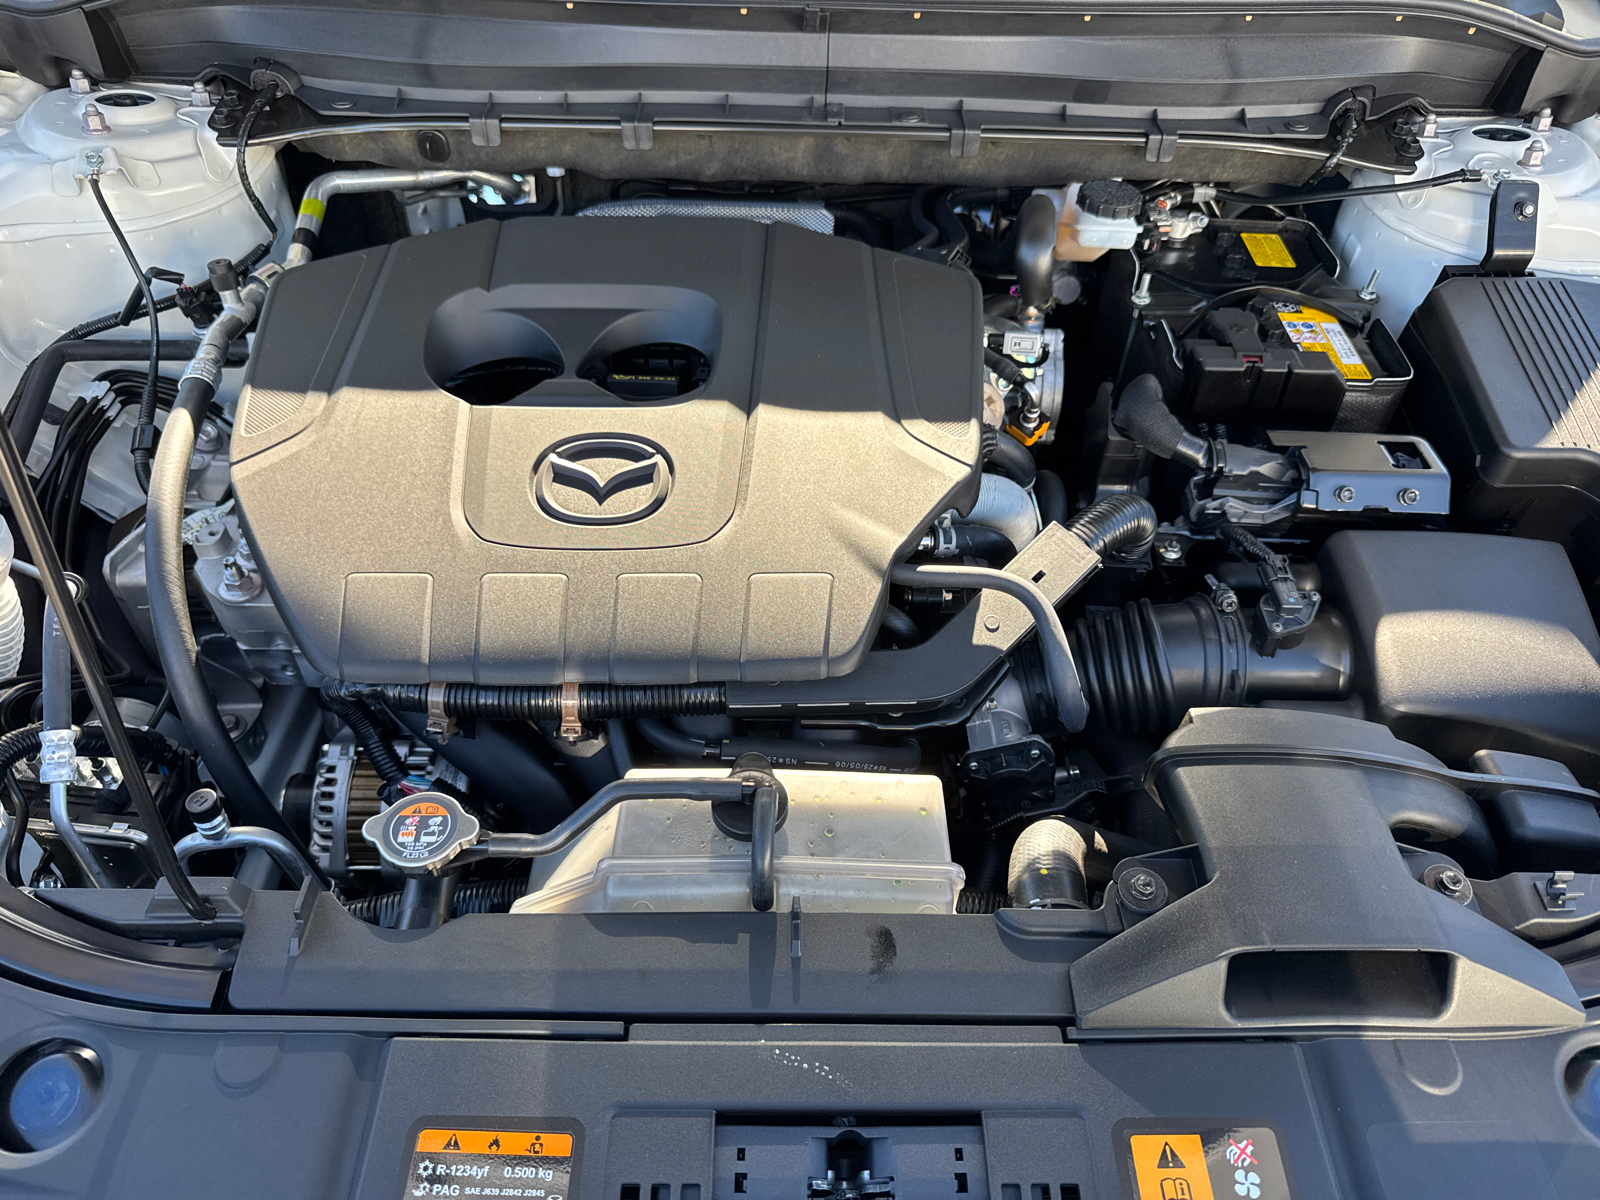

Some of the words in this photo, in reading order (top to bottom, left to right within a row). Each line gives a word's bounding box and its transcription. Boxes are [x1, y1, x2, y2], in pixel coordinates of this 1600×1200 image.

[436, 1164, 490, 1179] R-1234yf
[504, 1167, 536, 1178] 0.500
[538, 1168, 553, 1182] kg
[432, 1184, 460, 1196] PAG
[464, 1187, 481, 1195] SAE
[481, 1188, 500, 1196] J639
[500, 1188, 523, 1196] J2842
[523, 1189, 545, 1197] J2845
